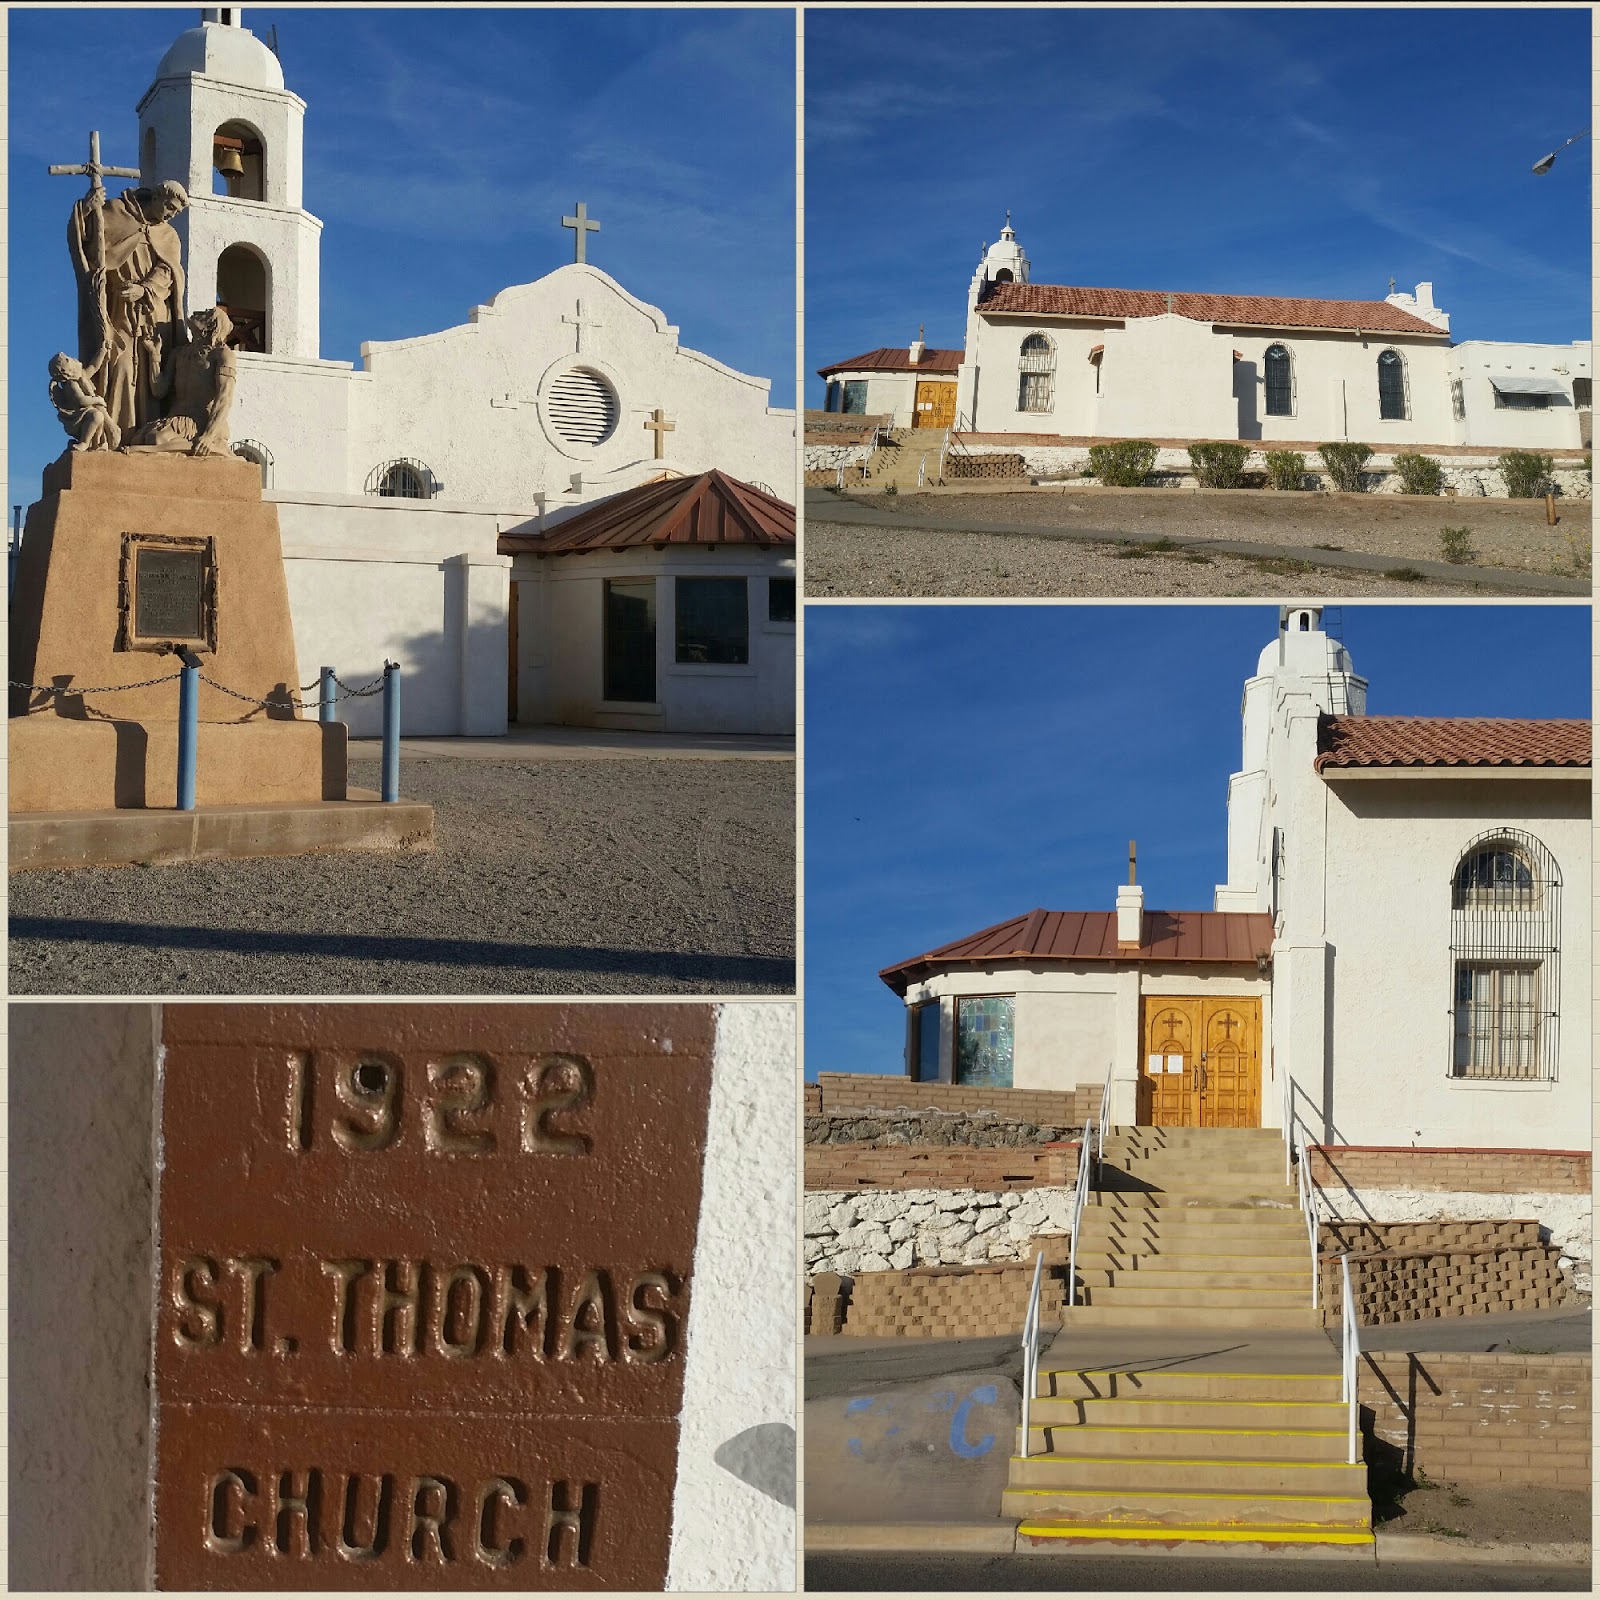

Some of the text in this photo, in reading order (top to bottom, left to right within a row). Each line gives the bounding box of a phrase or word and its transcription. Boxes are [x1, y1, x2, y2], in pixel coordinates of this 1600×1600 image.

[285, 1050, 597, 1157] 1922
[172, 1254, 686, 1364] ST. THOMAS
[203, 1467, 600, 1570] CHURCH
